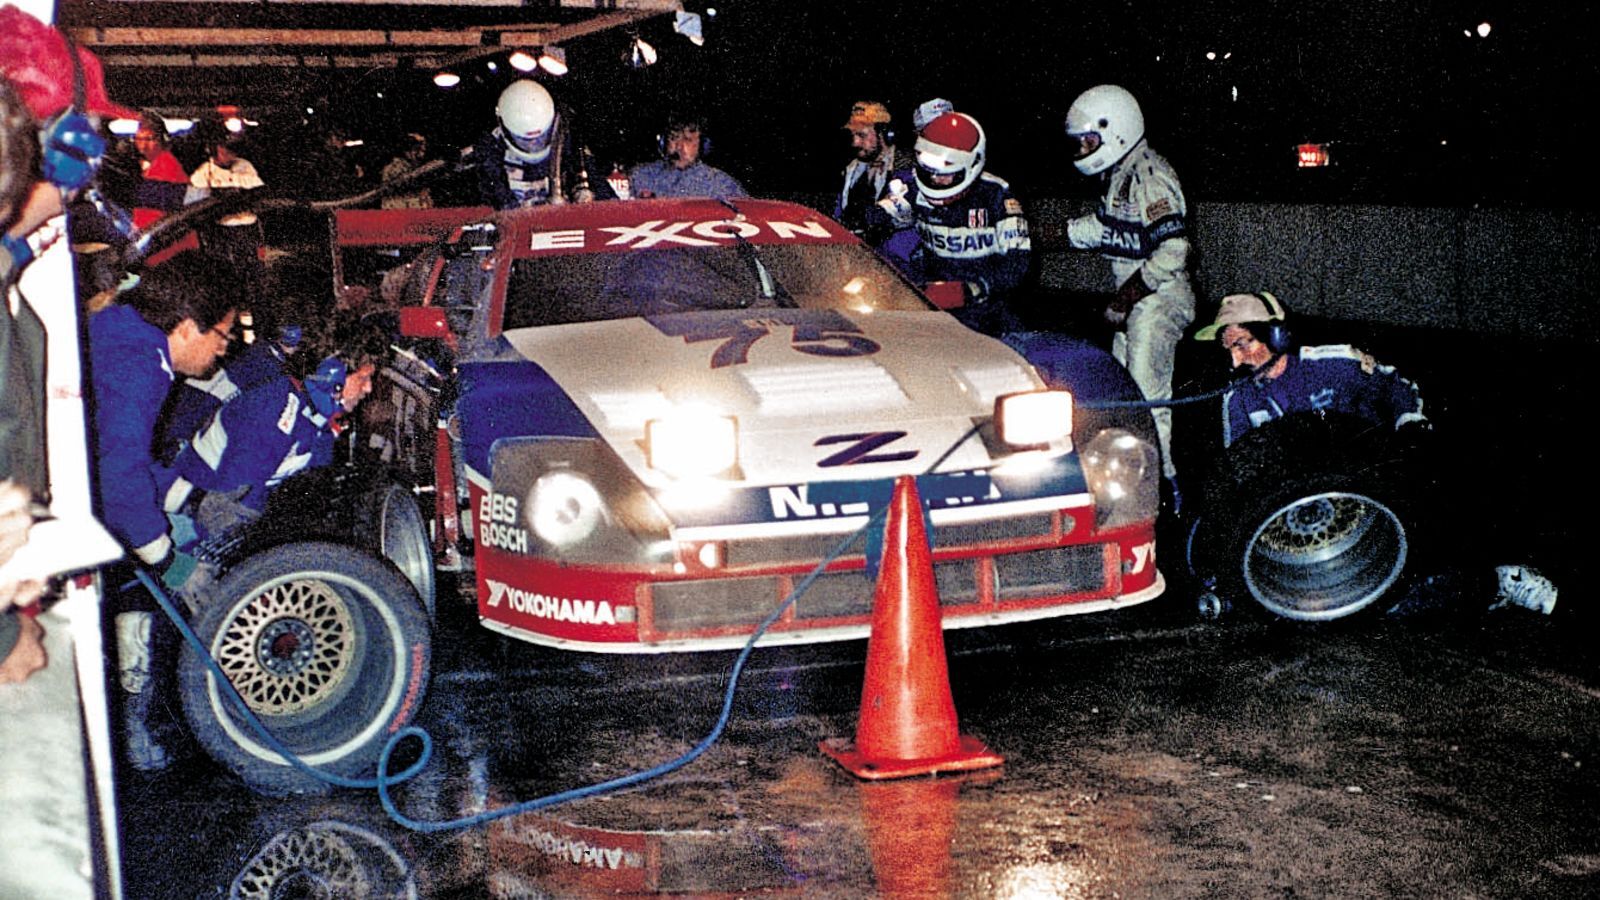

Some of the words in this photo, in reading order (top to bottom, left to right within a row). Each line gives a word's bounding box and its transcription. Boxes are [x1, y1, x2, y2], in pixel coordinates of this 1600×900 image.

[529, 219, 832, 251] EXXON
[1101, 224, 1141, 251] SAN
[683, 313, 882, 369] 75
[812, 430, 920, 468] Z
[479, 494, 518, 524] BBS
[480, 522, 528, 553] BOSCH
[505, 586, 616, 626] YOKOHAMA
